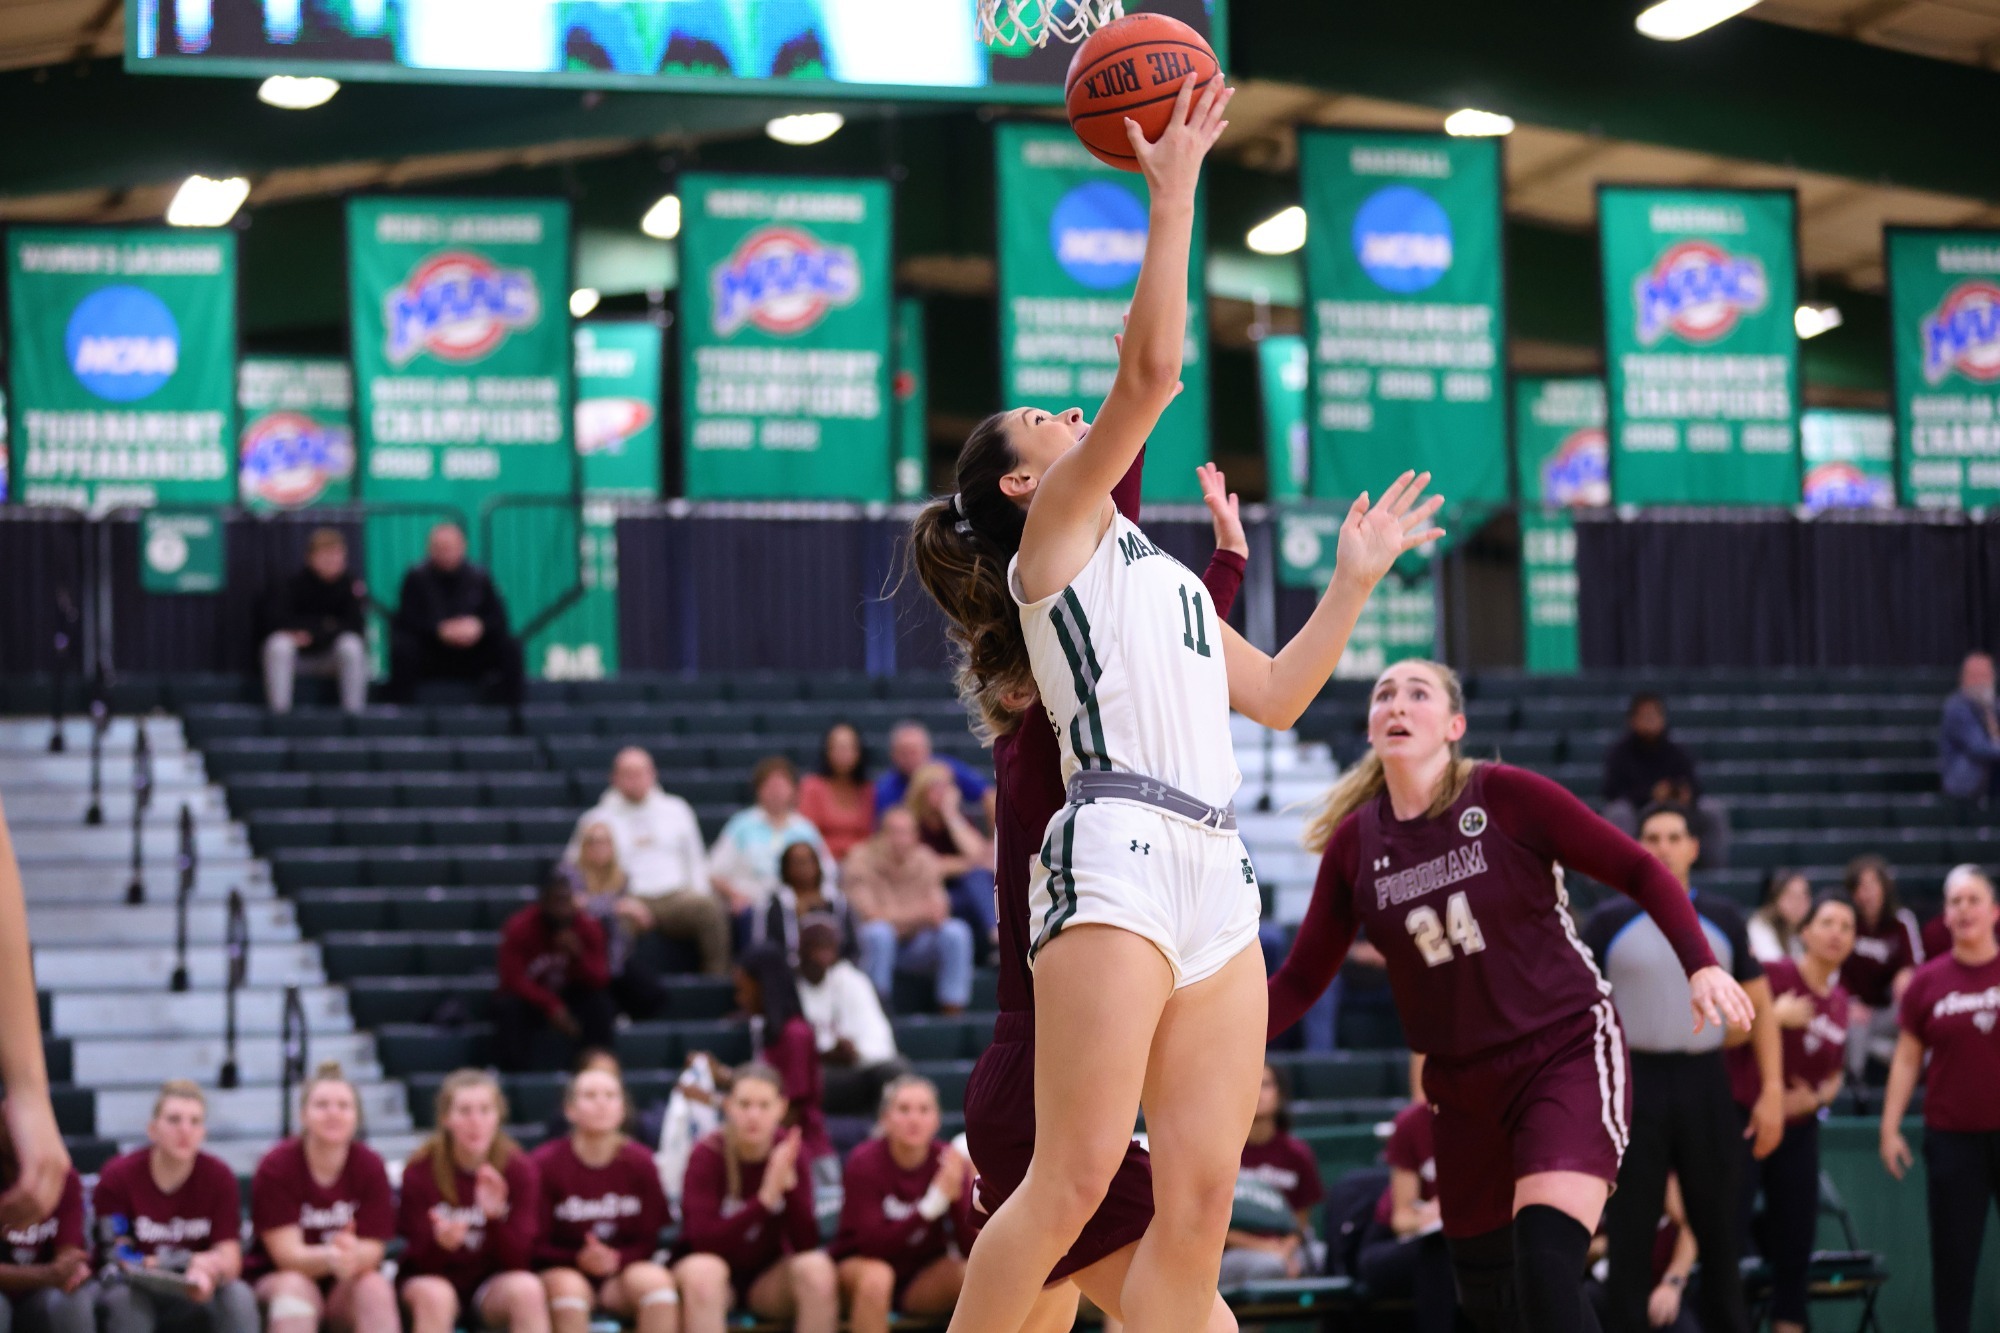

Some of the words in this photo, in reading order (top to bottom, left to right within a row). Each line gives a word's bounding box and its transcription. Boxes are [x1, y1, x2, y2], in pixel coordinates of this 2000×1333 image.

[1084, 58, 1141, 99] ROCK
[1146, 52, 1196, 86] THE
[76, 337, 176, 372] NCAA
[1179, 584, 1211, 658] 11
[1374, 840, 1488, 910] FORDHAM
[1405, 891, 1487, 968] 24
